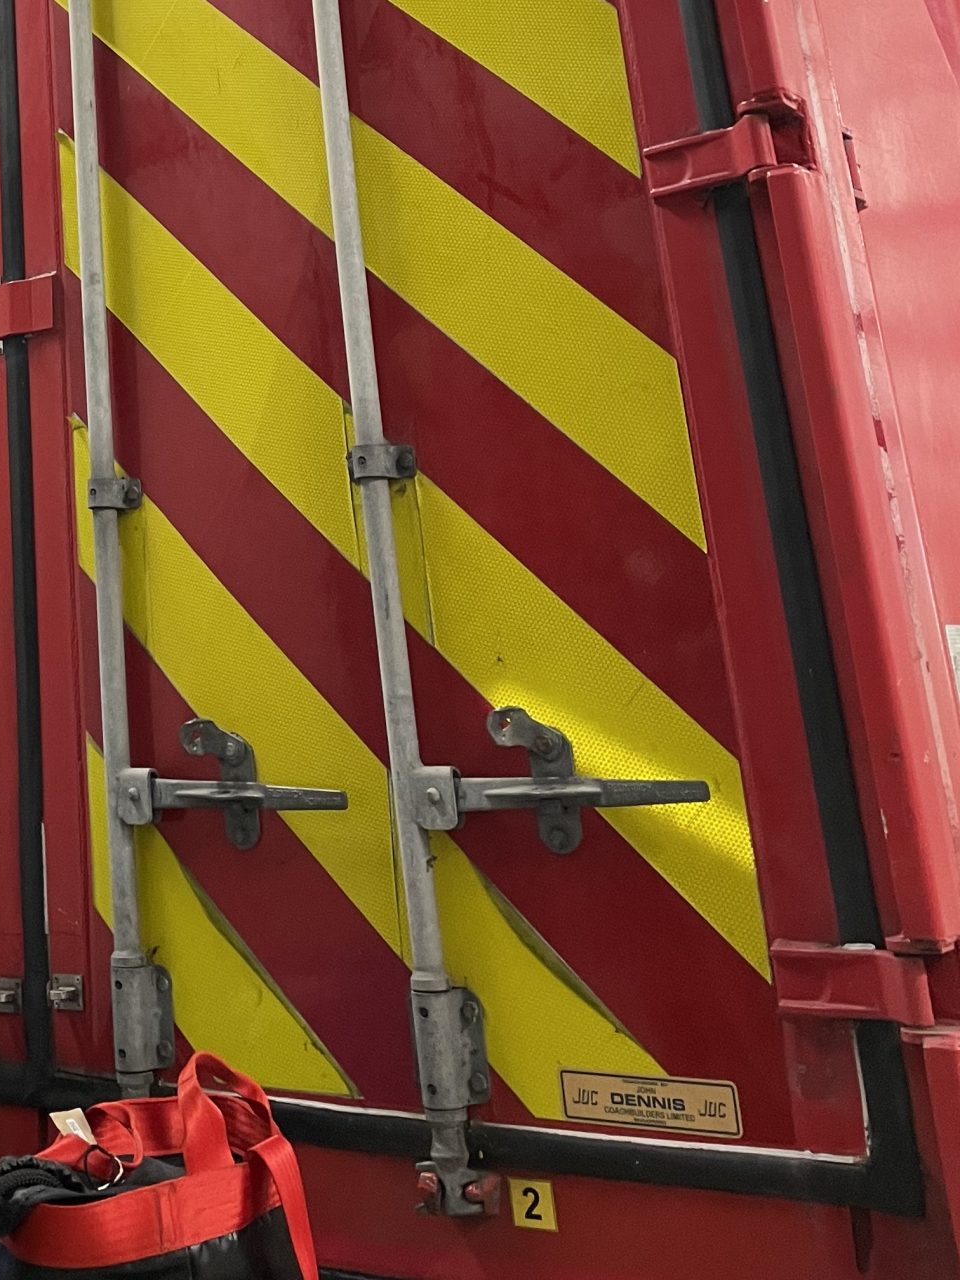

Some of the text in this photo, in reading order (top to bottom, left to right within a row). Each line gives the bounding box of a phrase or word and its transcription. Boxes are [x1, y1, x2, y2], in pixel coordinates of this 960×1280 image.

[637, 1086, 657, 1095] JOHN
[610, 1092, 686, 1112] DENNIS
[604, 1106, 666, 1120] COACHBUILDERS
[667, 1111, 696, 1122] LIMITED
[522, 1187, 543, 1221] 2
